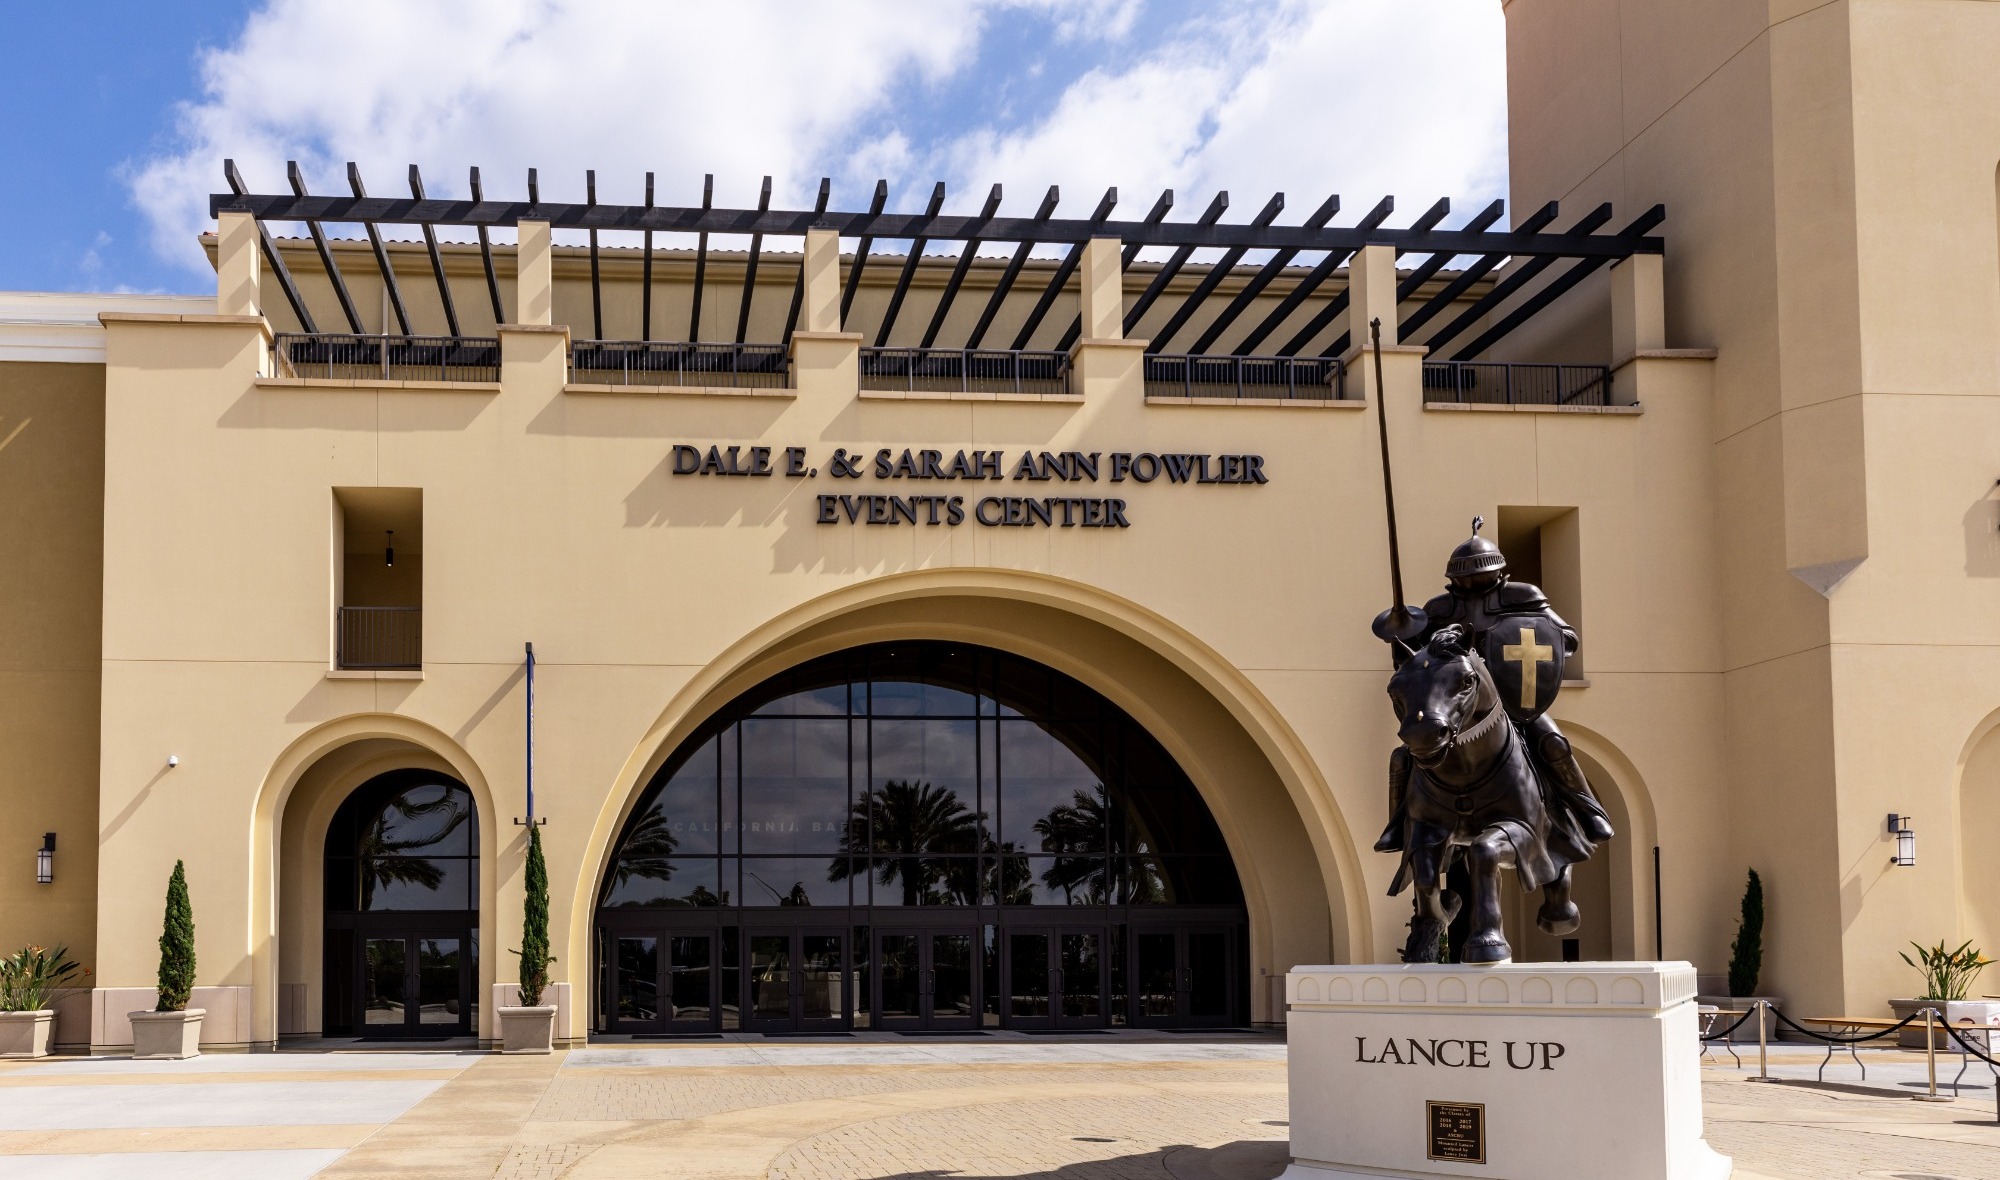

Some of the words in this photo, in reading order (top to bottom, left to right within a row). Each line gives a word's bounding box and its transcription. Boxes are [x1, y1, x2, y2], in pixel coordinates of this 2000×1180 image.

[673, 444, 774, 478] DALE
[785, 447, 818, 479] E.
[830, 448, 865, 480] &
[875, 448, 1005, 482] SARAH
[1013, 450, 1103, 483] ANN
[1109, 452, 1270, 486] FOWLER
[816, 494, 965, 528] EVENTS
[975, 496, 1132, 530] CENTER
[674, 821, 799, 833] CALIFORNIA
[1354, 1036, 1491, 1069] LANCE
[1502, 1041, 1566, 1071] UP
